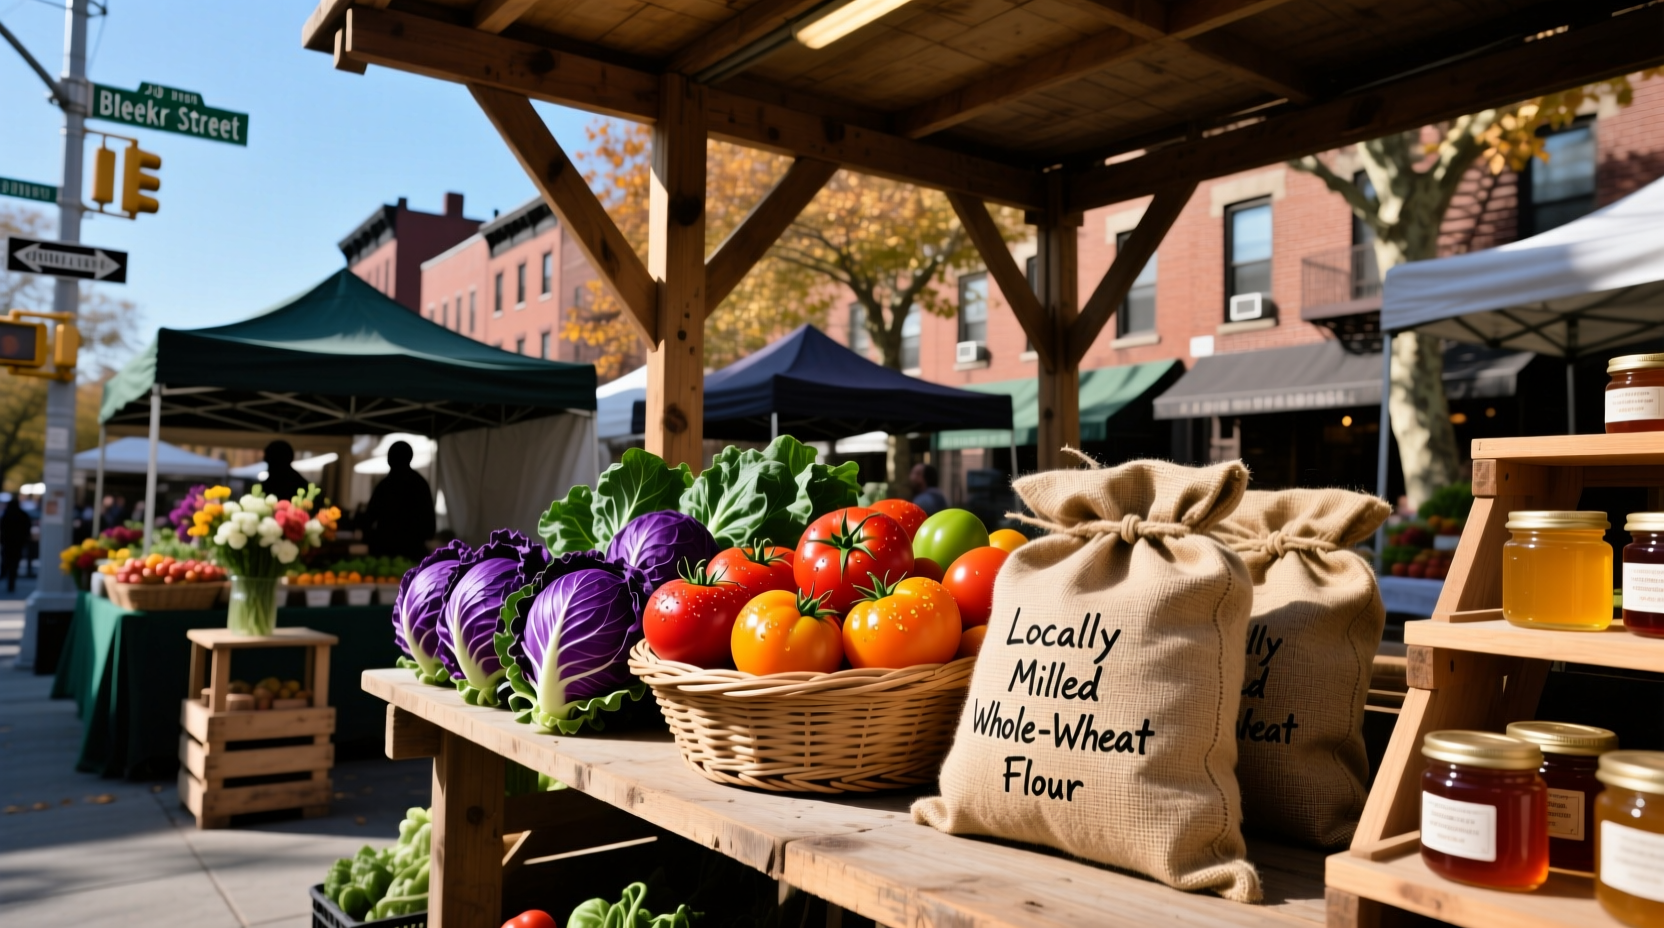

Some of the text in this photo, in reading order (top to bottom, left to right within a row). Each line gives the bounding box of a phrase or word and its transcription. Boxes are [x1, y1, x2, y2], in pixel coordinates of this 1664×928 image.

[100, 89, 170, 127] Bleekr
[177, 106, 240, 141] Street
[1007, 607, 1121, 665] Locally
[1008, 658, 1103, 702] Milled
[973, 698, 1155, 755] Whole-Wheat
[1003, 756, 1084, 801] Flour
